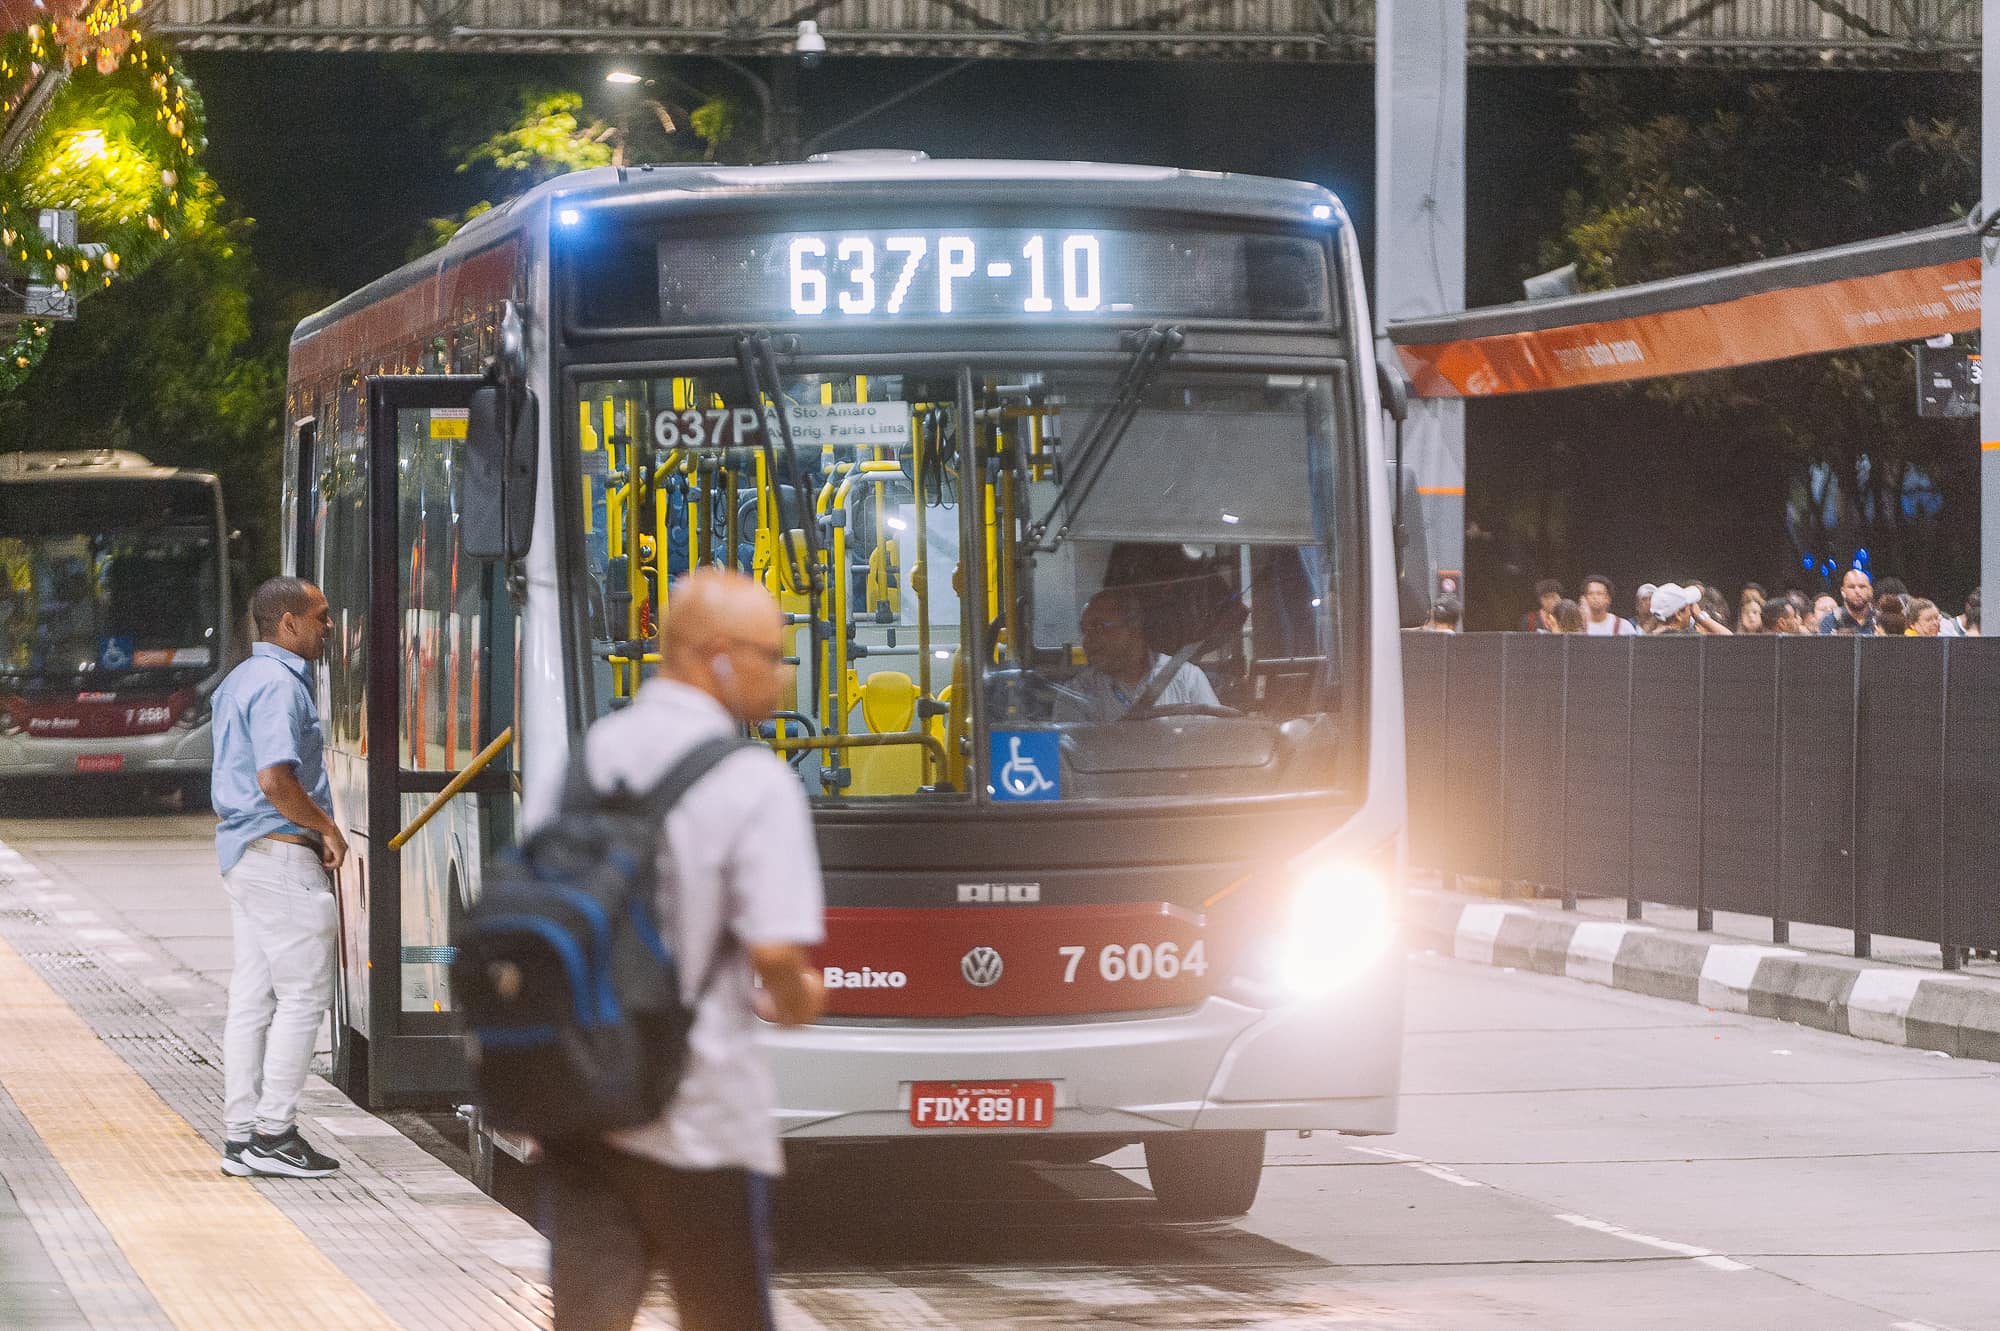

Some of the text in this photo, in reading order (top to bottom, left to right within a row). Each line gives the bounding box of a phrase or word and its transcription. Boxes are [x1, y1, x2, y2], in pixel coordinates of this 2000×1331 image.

[789, 235, 1100, 315] 637P-10
[792, 407, 821, 418] Sto.
[826, 406, 877, 417] Amaro
[654, 407, 759, 448] 637P
[830, 425, 865, 436] Faria
[871, 423, 905, 434] Lima
[1059, 940, 1209, 983] 7 6064
[823, 966, 908, 988] Baixo
[917, 1097, 1043, 1122] FDX-8911
